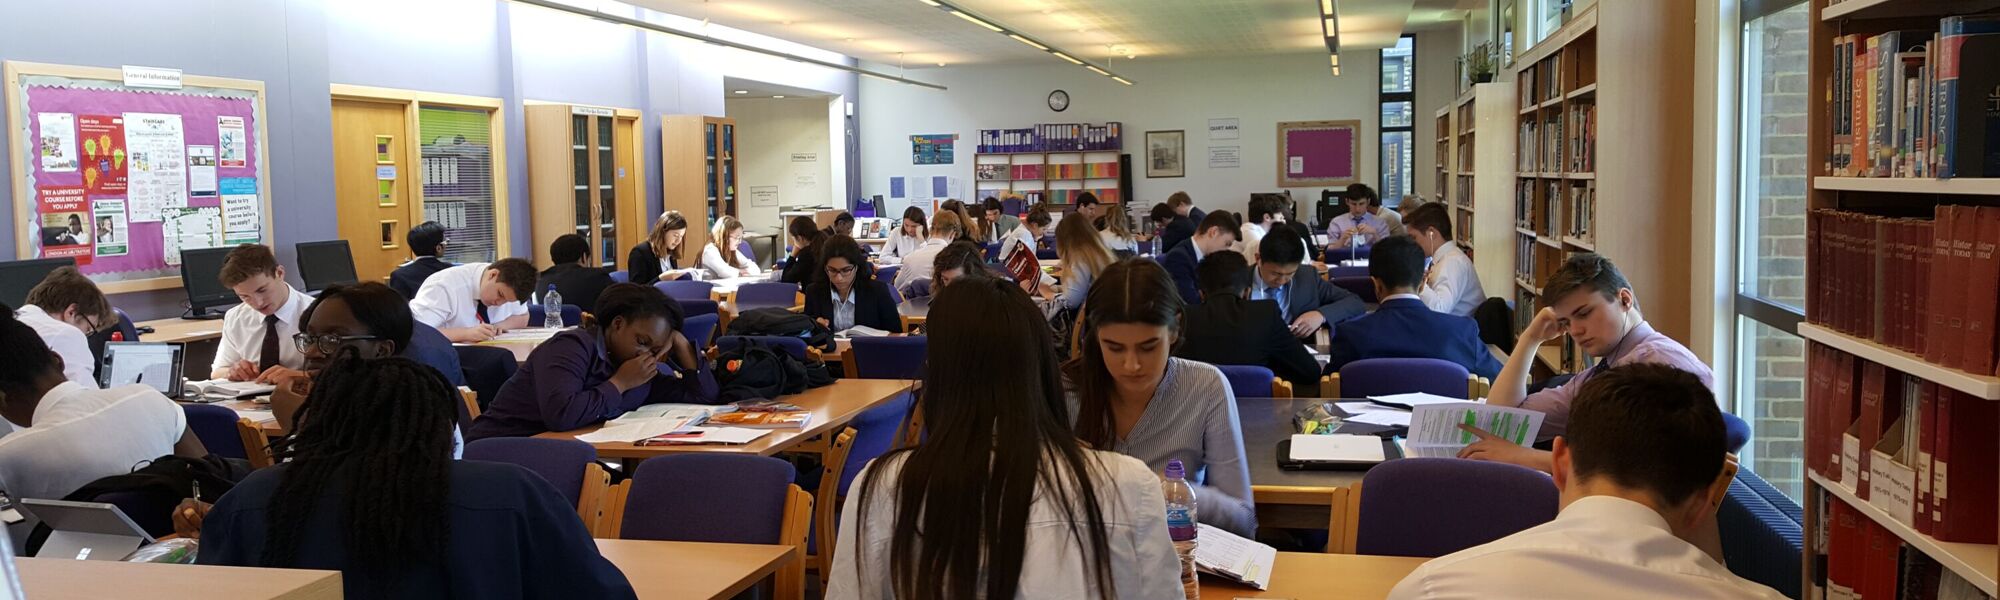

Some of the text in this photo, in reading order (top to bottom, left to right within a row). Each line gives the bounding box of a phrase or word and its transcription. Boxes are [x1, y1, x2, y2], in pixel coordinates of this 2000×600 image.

[148, 73, 180, 81] Information
[1874, 51, 1889, 134] Spanish
[1853, 79, 1863, 147] Spanish
[1939, 81, 1948, 146] FRENC
[41, 189, 52, 197] TRY
[57, 188, 85, 196] UNIVERSITY
